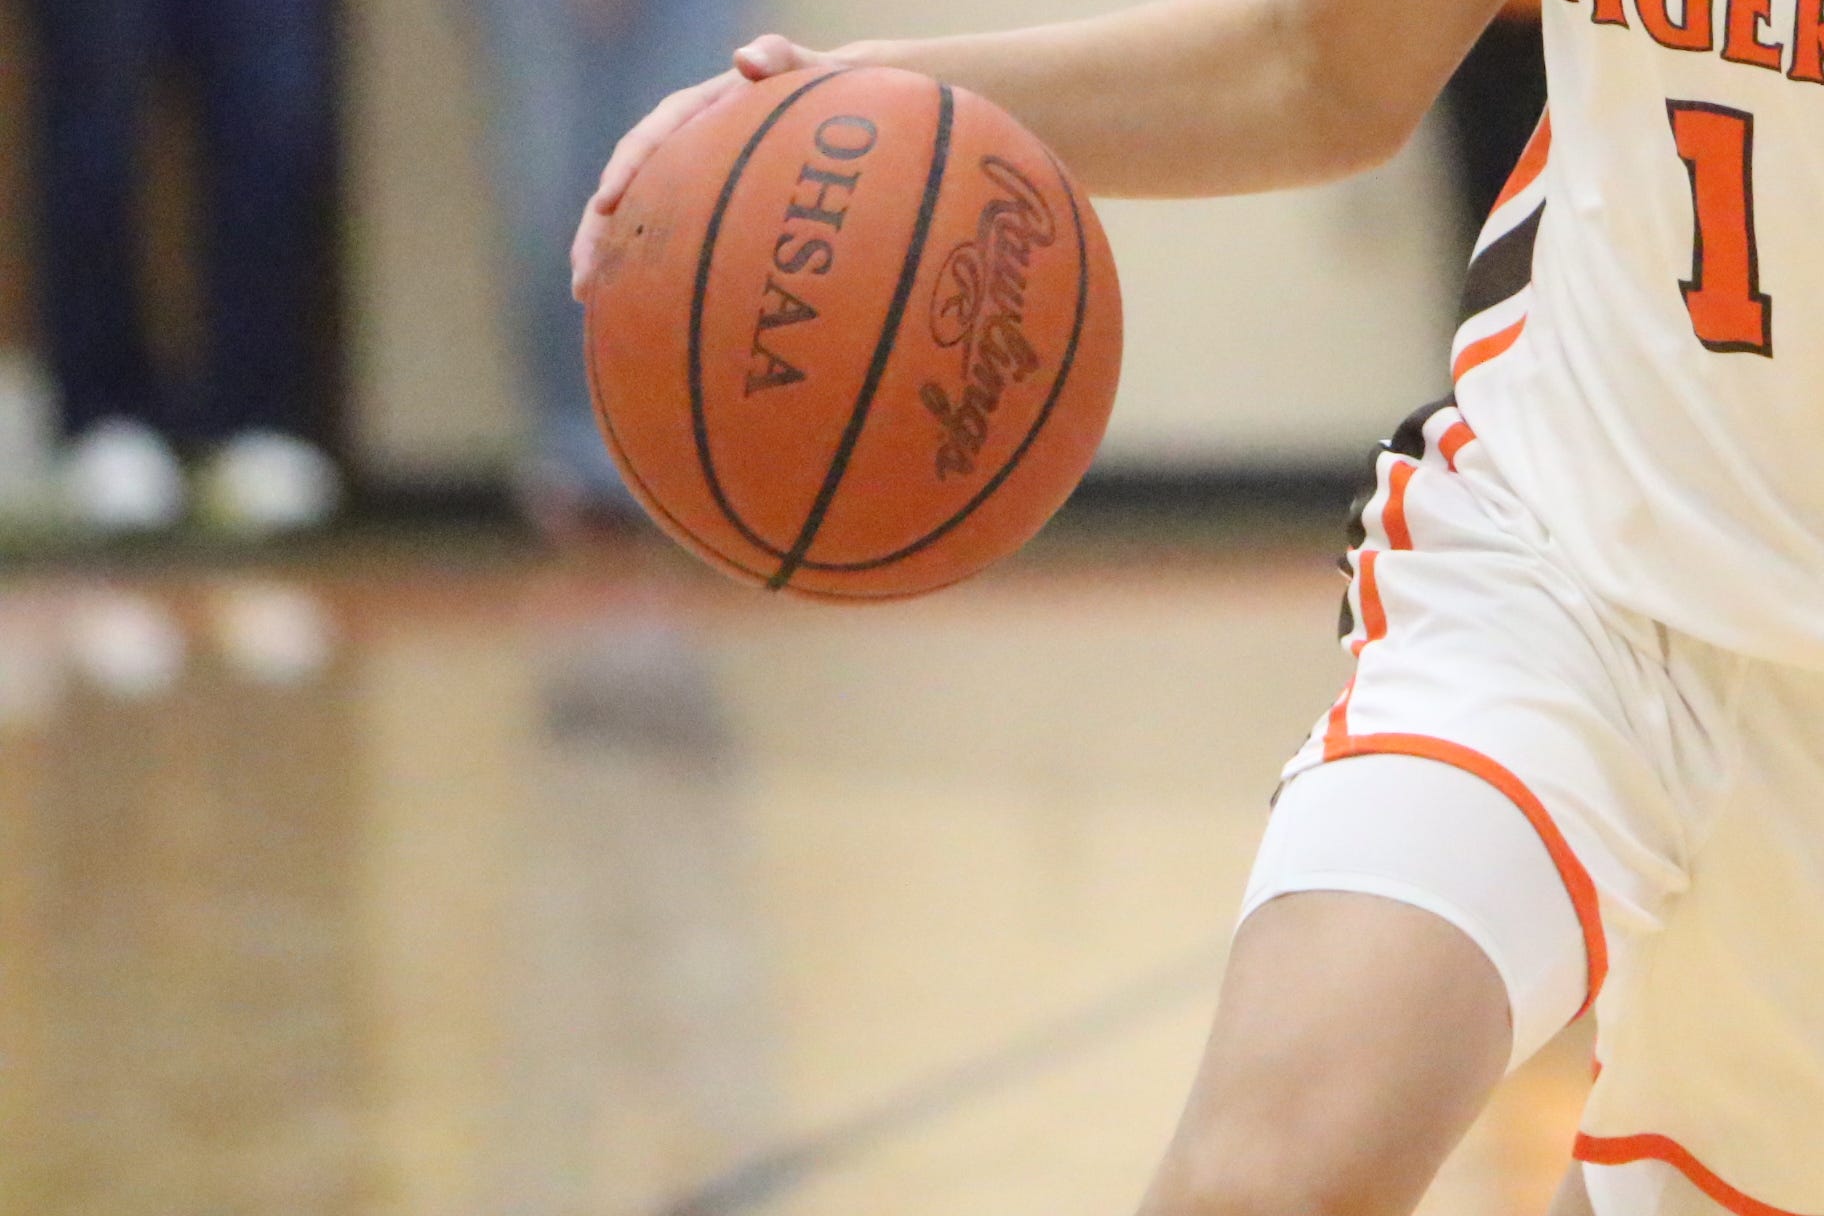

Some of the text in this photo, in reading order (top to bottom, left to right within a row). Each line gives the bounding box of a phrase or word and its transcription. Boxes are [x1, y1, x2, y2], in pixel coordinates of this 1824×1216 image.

[743, 113, 879, 399] OHSAA
[918, 154, 1056, 482] Rawlings
[1665, 97, 1774, 359] 1
